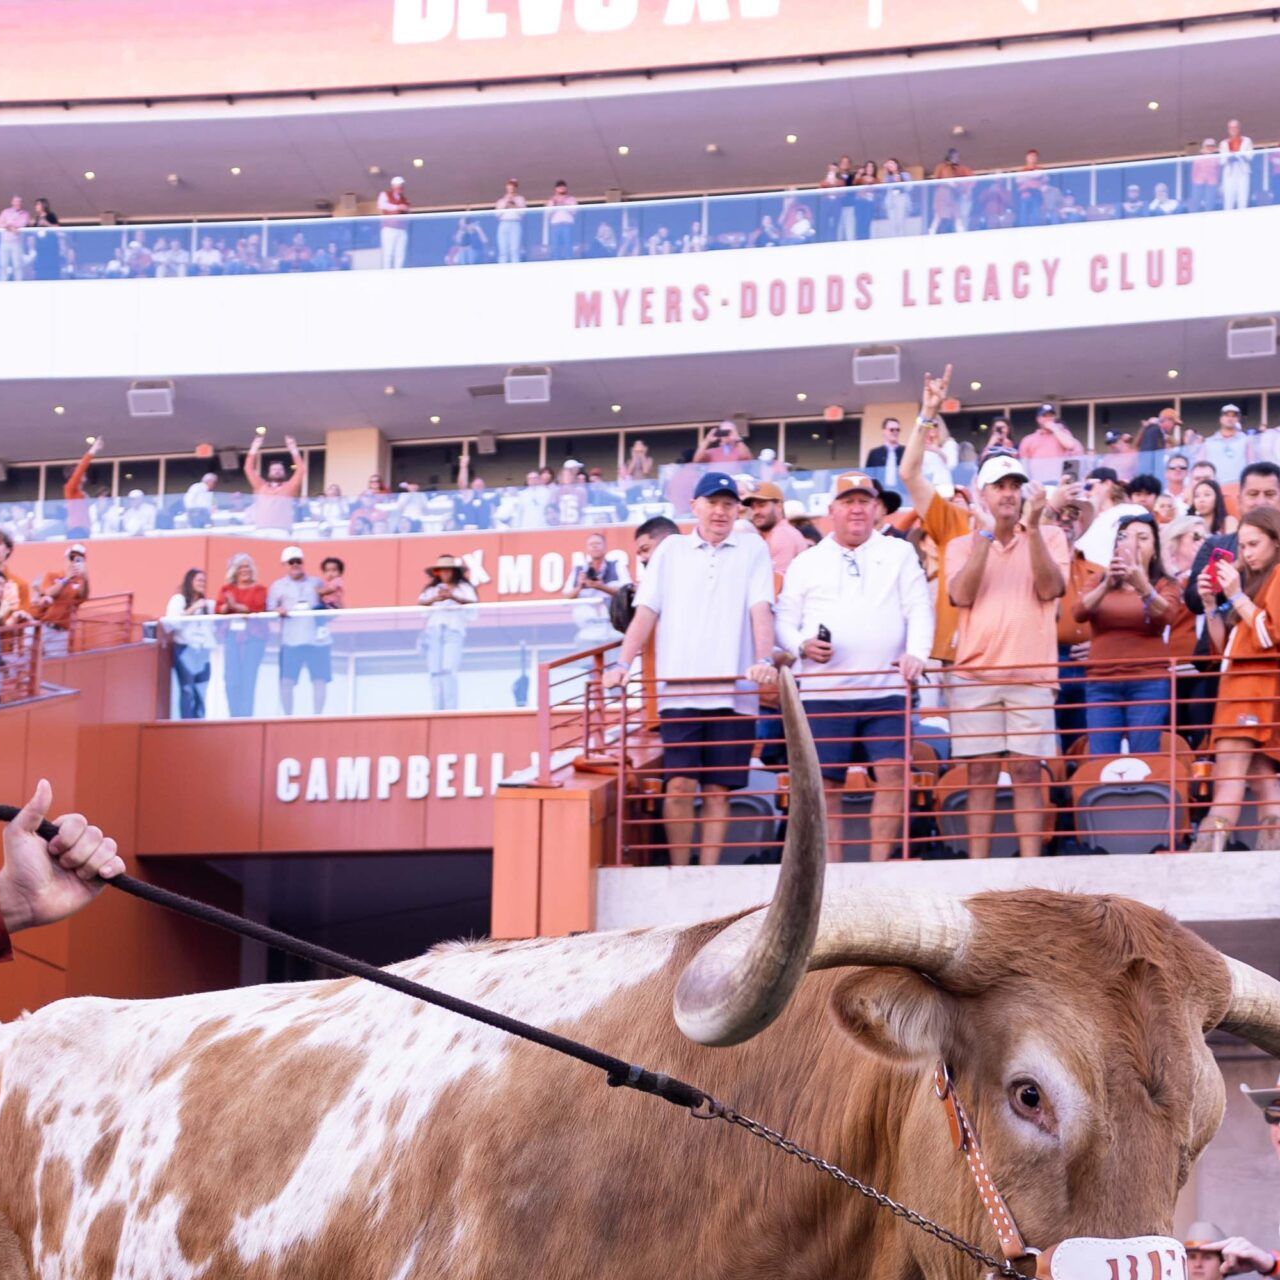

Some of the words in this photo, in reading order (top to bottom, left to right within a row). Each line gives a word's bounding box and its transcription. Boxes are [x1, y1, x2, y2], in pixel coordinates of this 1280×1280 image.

[901, 257, 1061, 308] LEGACY
[1089, 246, 1195, 294] CLUB
[276, 751, 504, 802] CAMPBELL
